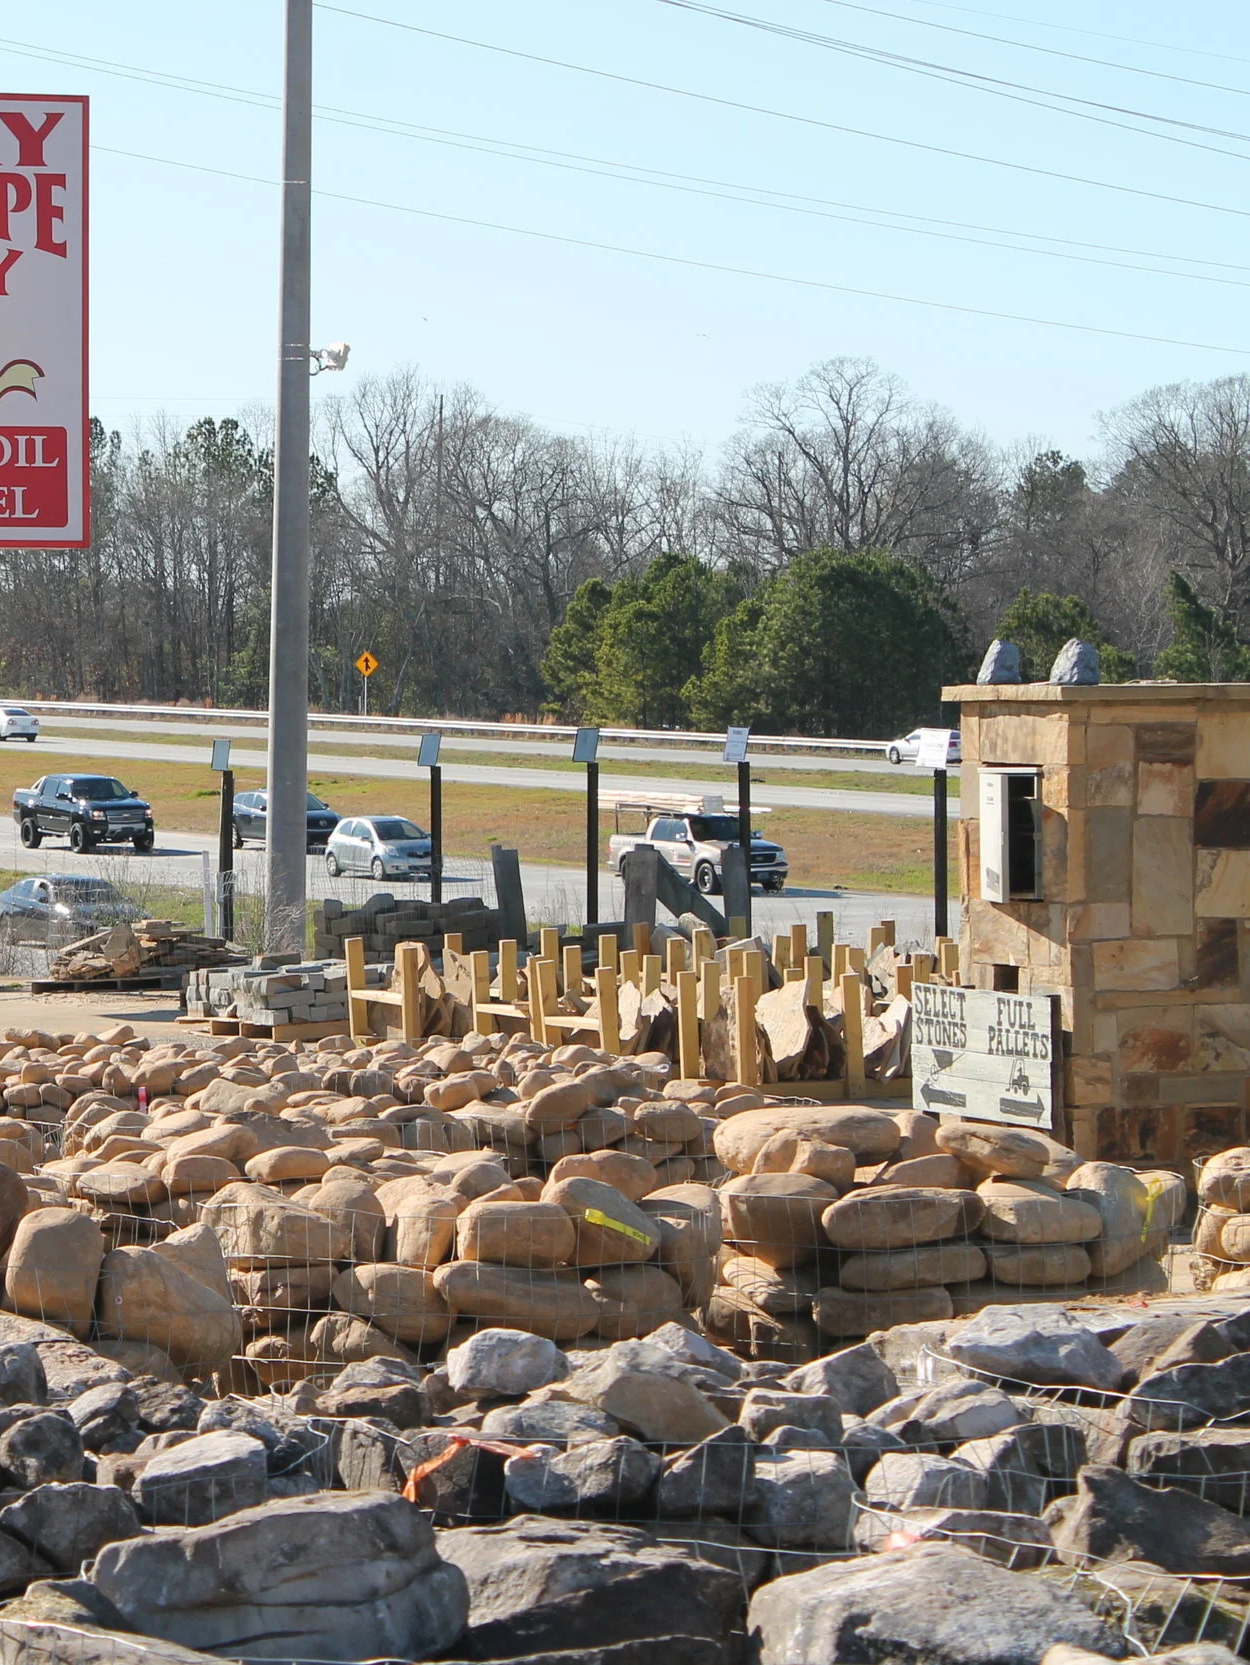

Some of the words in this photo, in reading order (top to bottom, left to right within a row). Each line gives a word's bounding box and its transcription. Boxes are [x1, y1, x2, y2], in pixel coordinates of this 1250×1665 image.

[914, 985, 966, 1022] SELECT
[996, 997, 1036, 1031] FULL
[915, 1016, 967, 1049] STONES
[988, 1025, 1049, 1060] PALLETS
